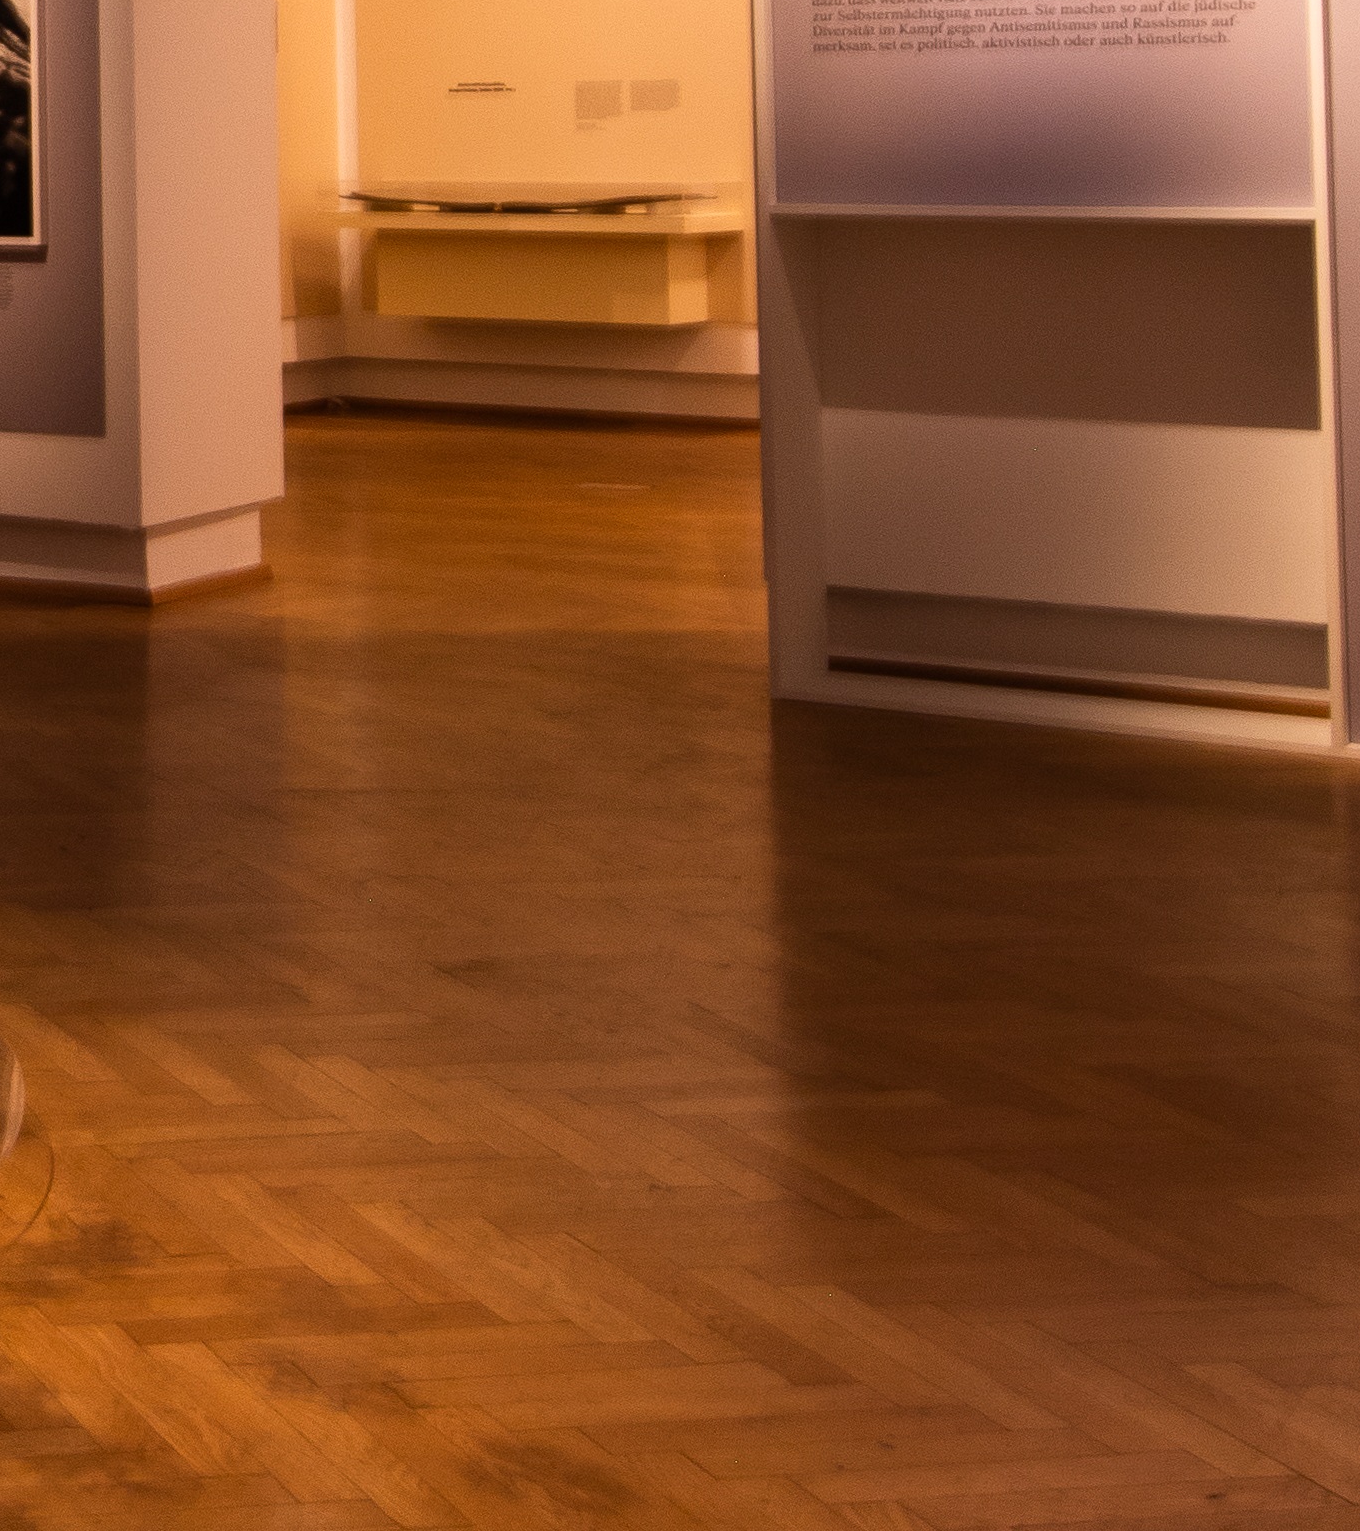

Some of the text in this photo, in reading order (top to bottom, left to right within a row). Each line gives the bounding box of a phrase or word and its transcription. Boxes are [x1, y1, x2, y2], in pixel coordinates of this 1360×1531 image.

[812, 15, 833, 23] zur
[1035, 6, 1055, 17] Sie
[1060, 4, 1116, 16] machen
[1121, 6, 1136, 15] so
[1140, 3, 1163, 14] auf
[1167, 2, 1188, 13] die
[1194, 0, 1258, 15] jüdische
[878, 41, 897, 52] sei
[899, 43, 914, 51] es
[982, 37, 1060, 49] aktivistisch
[1063, 36, 1096, 48] oder
[1099, 36, 1134, 47] auch
